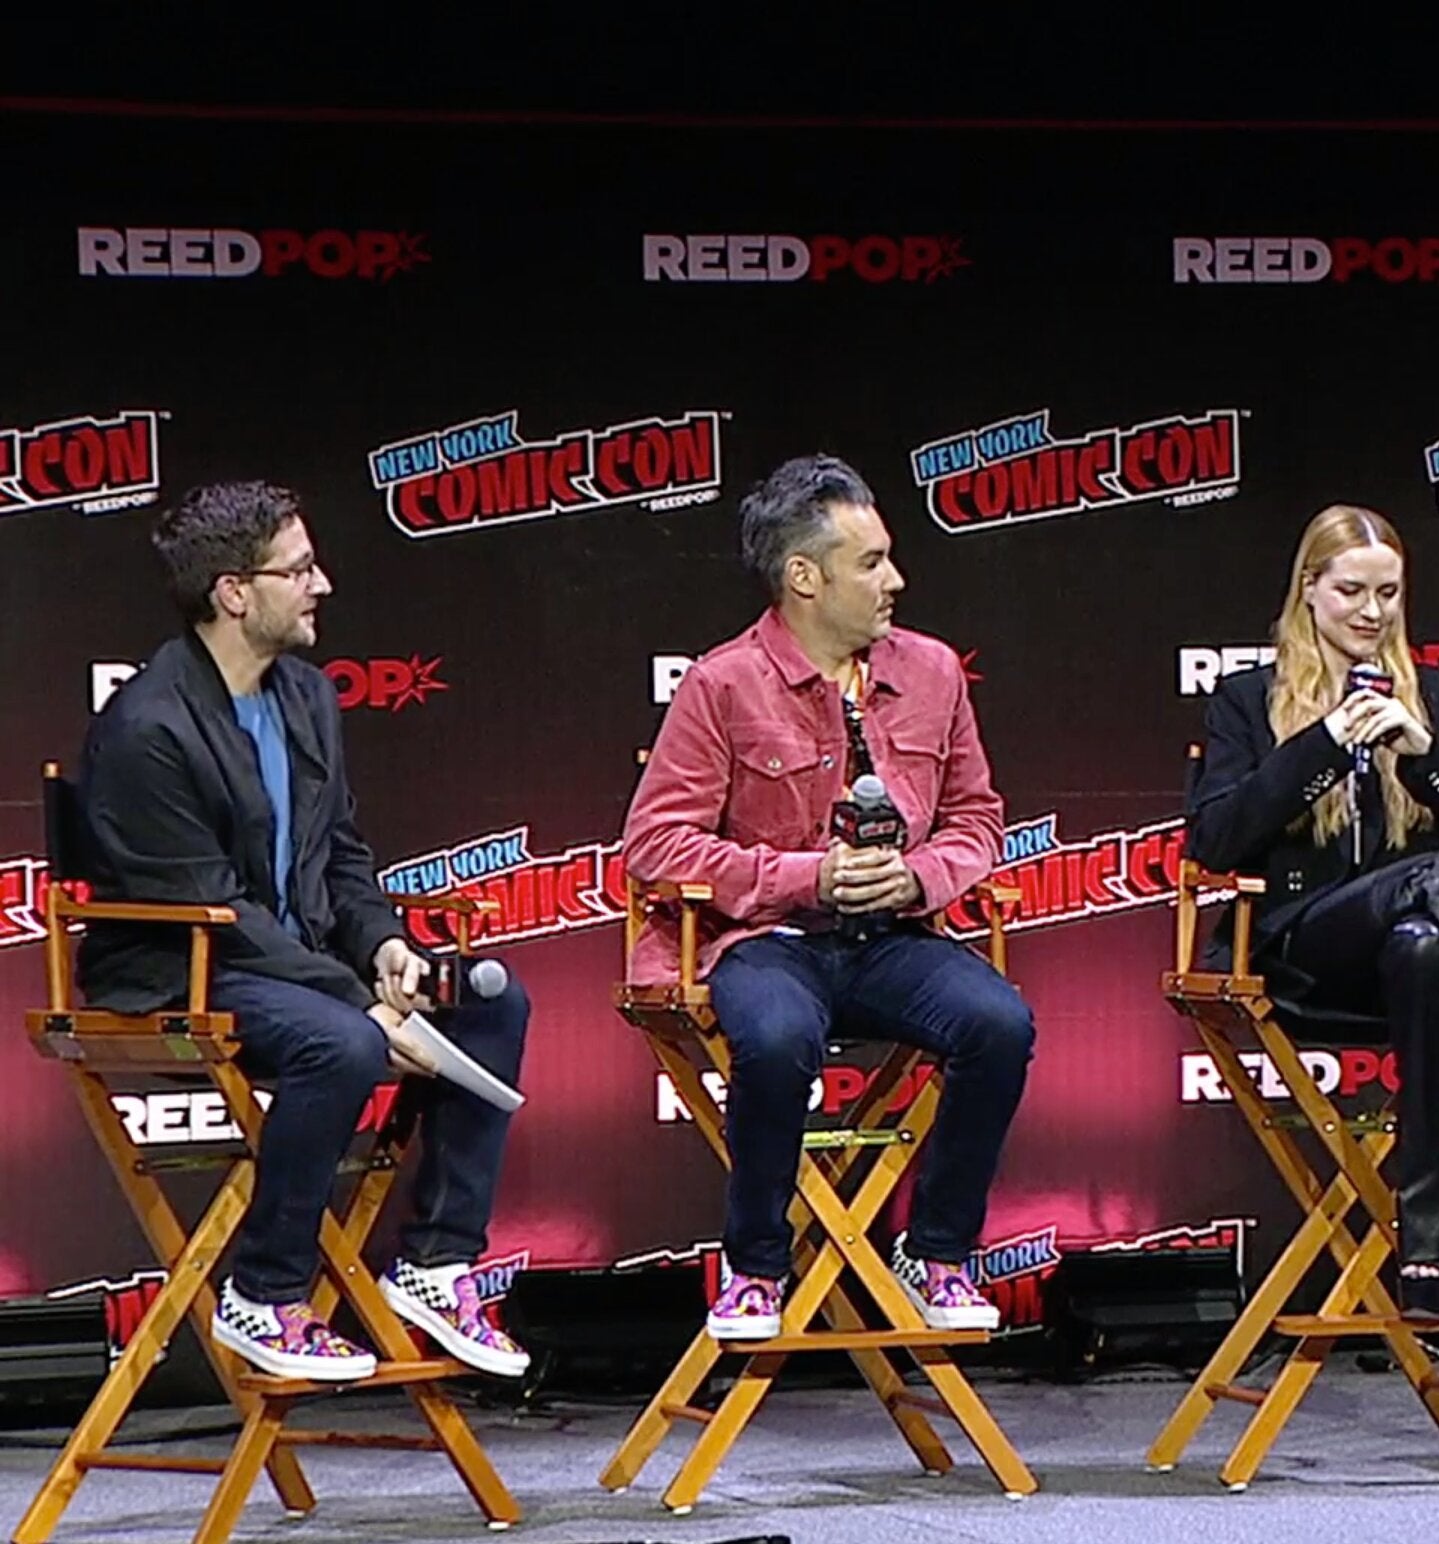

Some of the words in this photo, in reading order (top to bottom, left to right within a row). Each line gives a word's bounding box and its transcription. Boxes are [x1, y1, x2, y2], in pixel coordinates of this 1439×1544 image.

[78, 227, 399, 277] REEDPOP
[643, 234, 941, 281] REEDPOP
[25, 420, 147, 493] CON
[375, 440, 437, 481] NEW
[443, 418, 514, 461] YORK
[401, 441, 583, 527] COMIC
[600, 420, 711, 494] CON
[917, 438, 973, 480] NEW
[978, 418, 1046, 459] YORK
[938, 440, 1111, 523] COMIC
[1125, 419, 1230, 490] CON
[384, 856, 447, 894] NEW
[452, 835, 524, 877] YORK
[1003, 823, 1051, 862] ORK
[985, 1235, 1050, 1274] YORK
